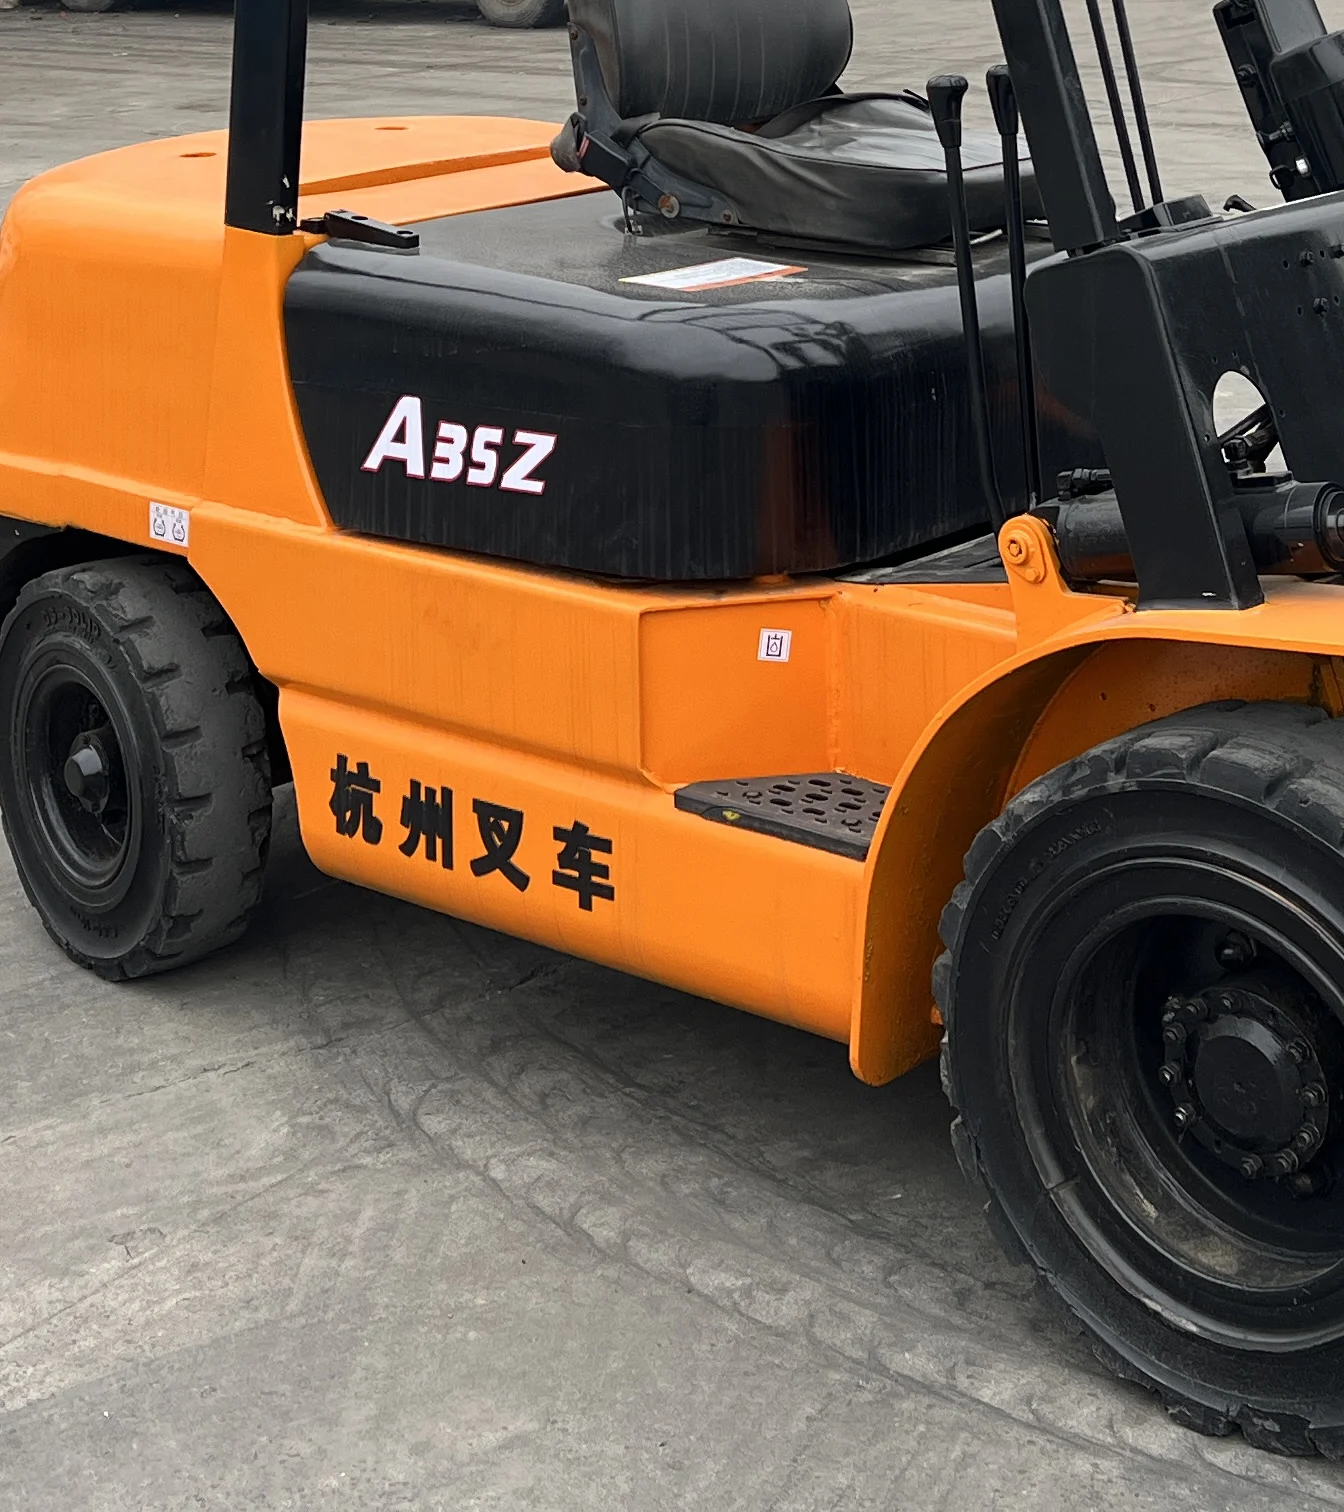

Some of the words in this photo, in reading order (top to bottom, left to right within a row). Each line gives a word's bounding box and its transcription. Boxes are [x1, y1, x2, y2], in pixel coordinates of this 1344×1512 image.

[360, 394, 558, 496] A35Z
[329, 753, 615, 912] 杭州叉车
